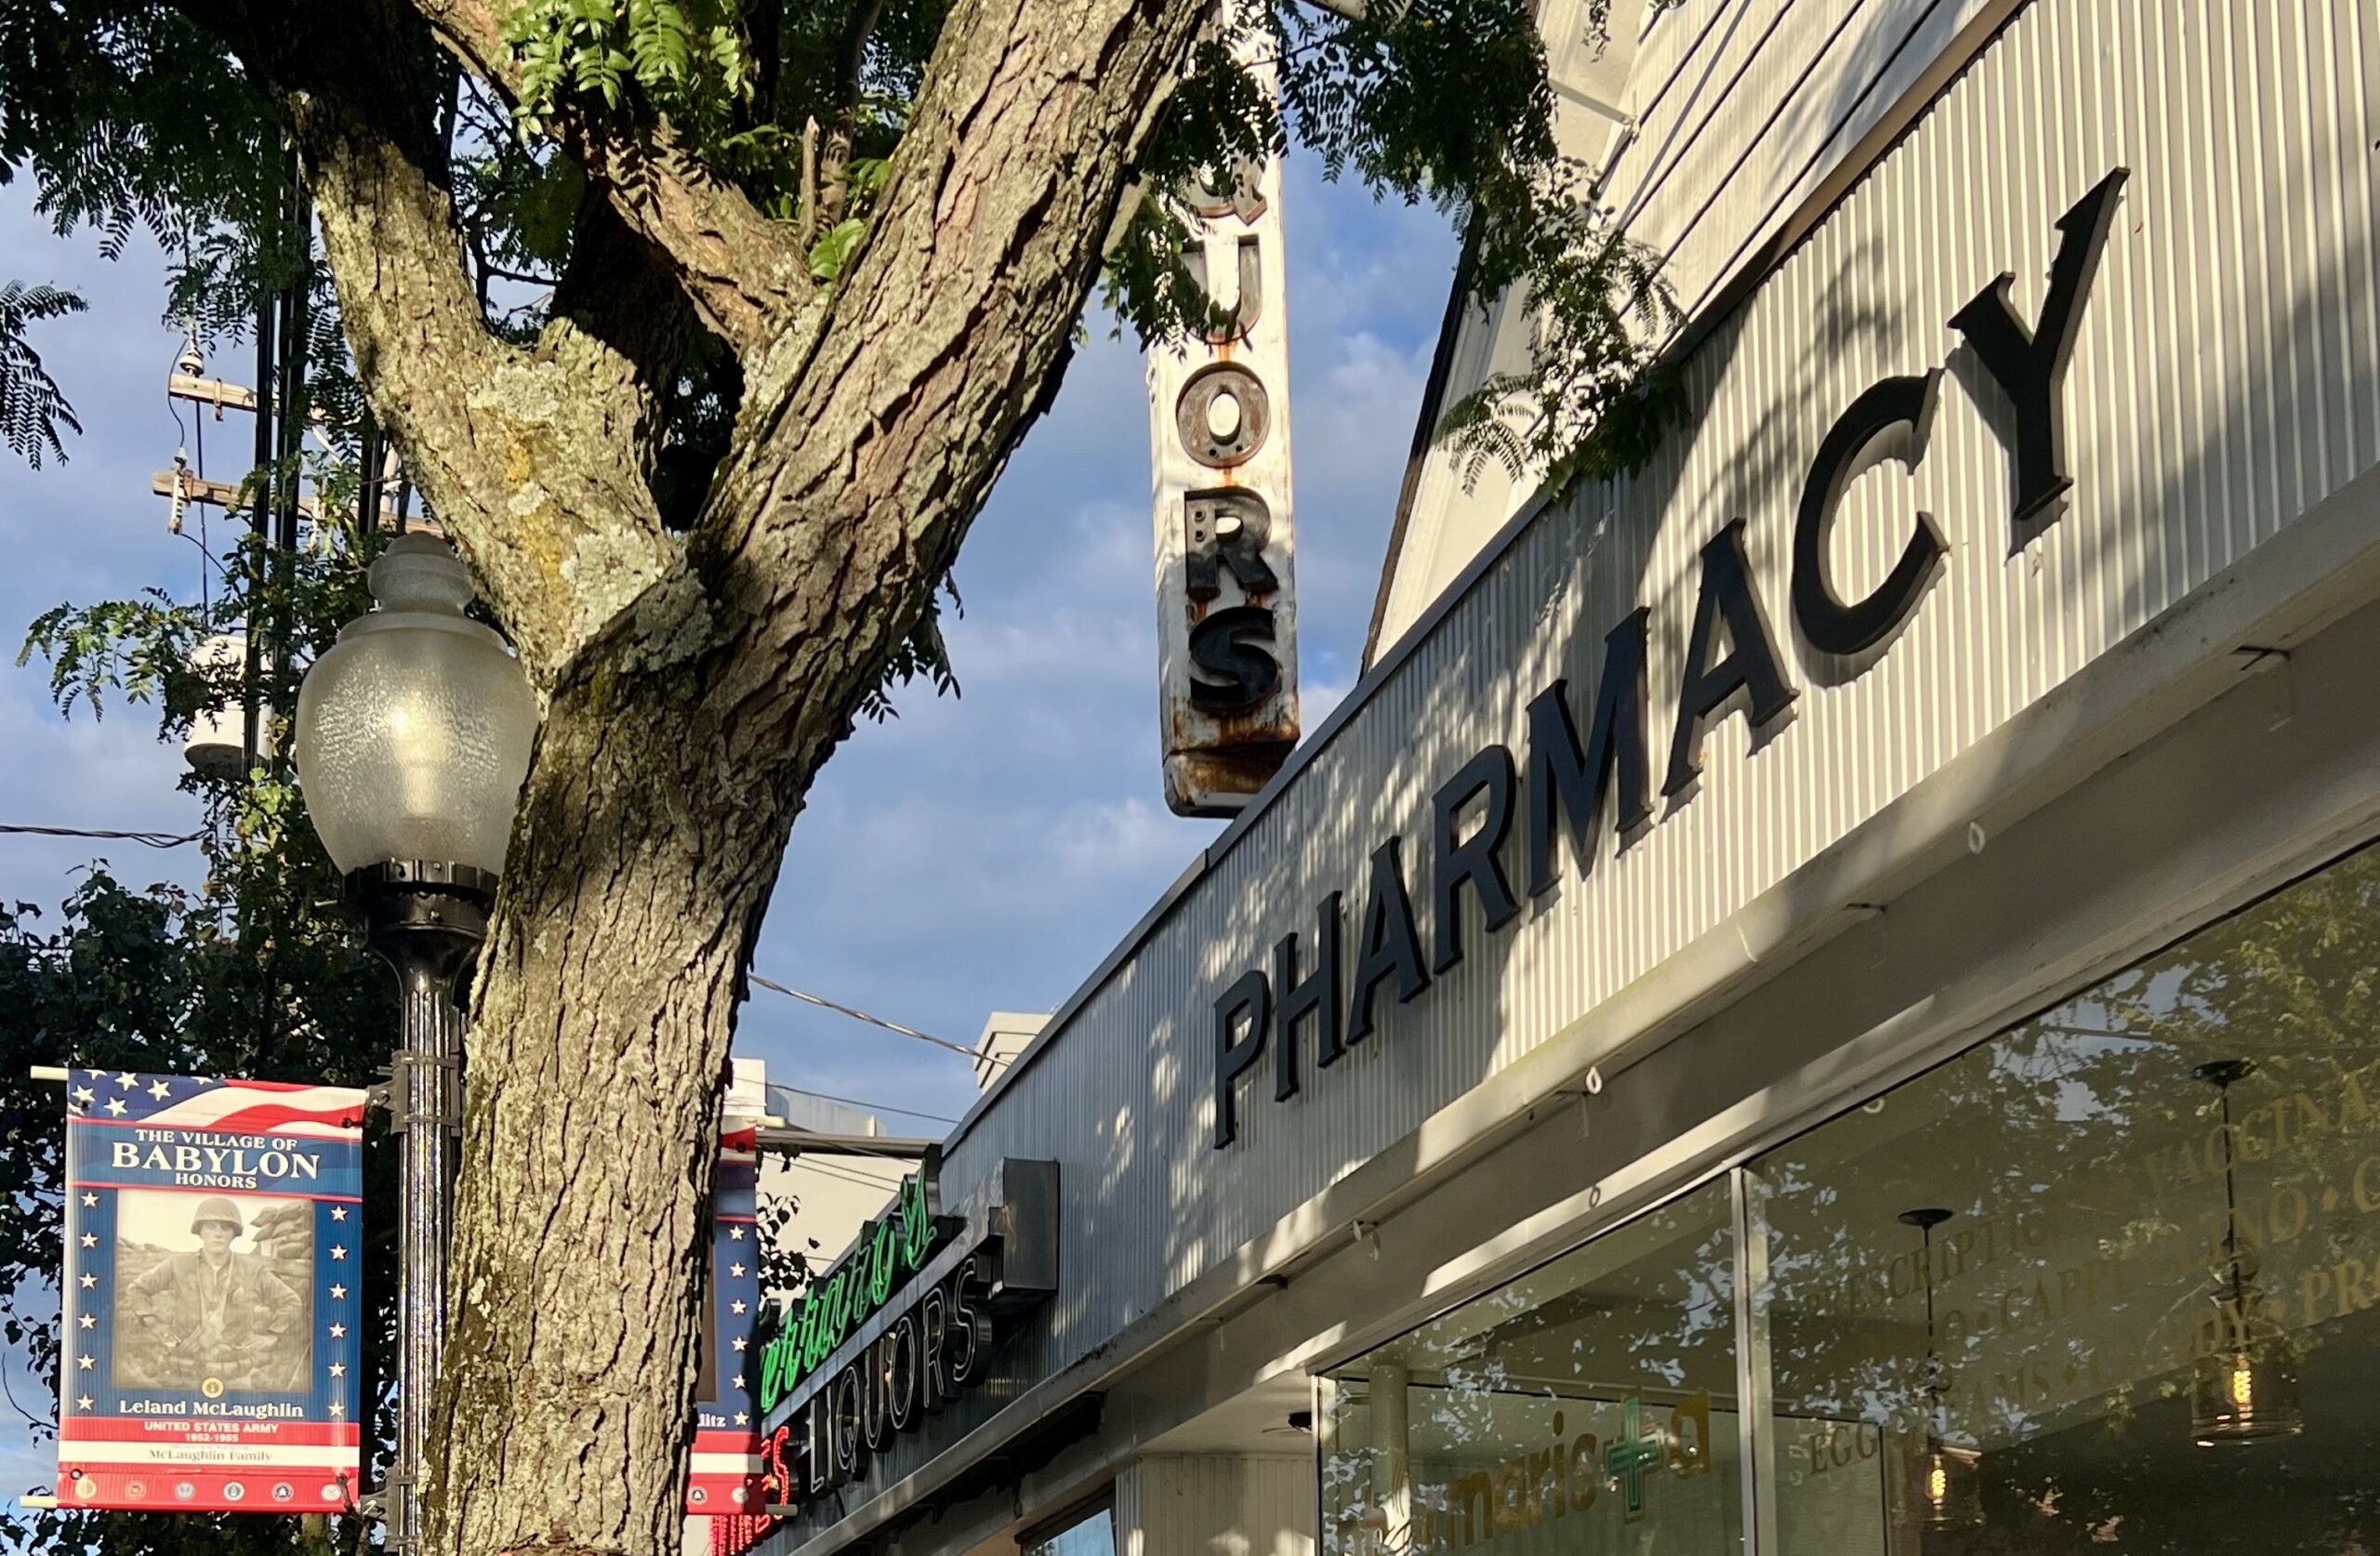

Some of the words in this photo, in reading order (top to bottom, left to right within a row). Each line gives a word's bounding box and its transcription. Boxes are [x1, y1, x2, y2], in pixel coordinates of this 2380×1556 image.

[1213, 166, 2130, 1151] PHARMACY
[135, 1128, 175, 1143] THE
[181, 1131, 266, 1150] VILLAGE
[271, 1138, 298, 1152] OF
[112, 1141, 320, 1180] BABYLON
[175, 1172, 258, 1189] HONORS
[810, 1257, 983, 1495] LIQUORS
[119, 1400, 186, 1416] Leland
[192, 1401, 304, 1420] McLaughlin
[144, 1420, 191, 1431] UNITED
[193, 1422, 240, 1432] STATES
[243, 1423, 279, 1433] ARMY
[185, 1432, 239, 1443] 1952-1955
[148, 1449, 225, 1462] McLaughlin
[230, 1450, 272, 1462] Family
[1808, 1423, 1879, 1476] EGG
